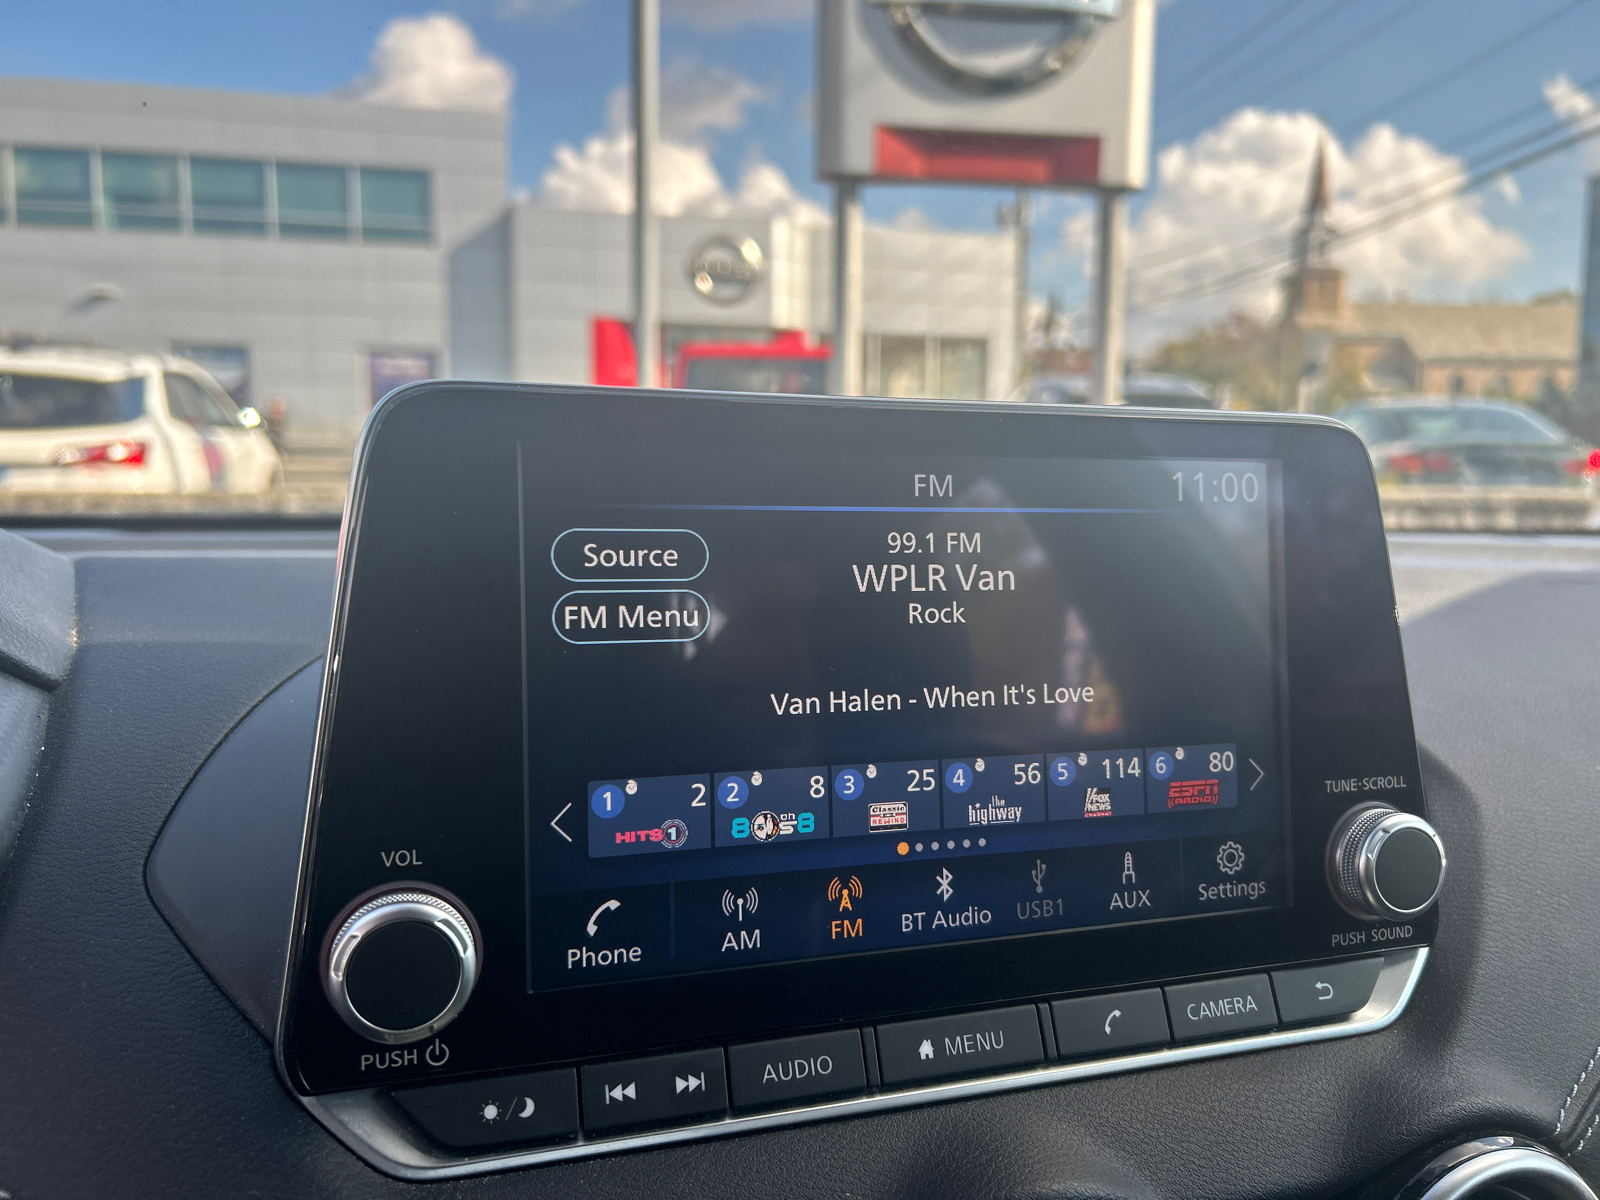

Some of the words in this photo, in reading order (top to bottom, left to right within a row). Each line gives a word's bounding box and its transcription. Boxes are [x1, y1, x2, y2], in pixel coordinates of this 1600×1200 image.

[913, 474, 953, 497] FM
[1171, 471, 1259, 503] 11:00
[887, 532, 935, 554] 99.1
[946, 532, 981, 553] FM
[583, 543, 679, 568] Source
[852, 565, 947, 593] WPLR
[955, 564, 1016, 592] Van
[564, 606, 607, 629] FM
[618, 605, 699, 630] Menu
[908, 601, 966, 624] Rock
[770, 693, 821, 716] Van
[829, 689, 902, 714] Halen
[923, 685, 995, 710] When
[1003, 683, 1036, 707] It's
[1044, 683, 1095, 705] Love
[1057, 763, 1069, 781] 5
[1102, 757, 1141, 779] 114
[1155, 757, 1167, 774] 6
[1209, 751, 1235, 773] 80
[906, 768, 936, 792] 25
[952, 768, 966, 787] 4
[1014, 762, 1042, 785] 56
[690, 783, 707, 807] 2
[726, 783, 740, 802] 2
[809, 775, 826, 798] 8
[843, 776, 856, 794] 3
[1168, 778, 1219, 798] ESPN
[602, 791, 613, 811] 1
[991, 795, 1006, 807] the
[1087, 803, 1112, 812] NEWS
[1092, 793, 1111, 803] FOX
[1174, 795, 1212, 805] RADIO
[872, 817, 905, 825] REWIND
[968, 804, 1022, 825] highway
[381, 849, 423, 867] VOL
[1109, 889, 1151, 911] AUX
[1198, 880, 1266, 902] Settings
[901, 911, 926, 932] BT
[931, 906, 992, 929] Audio
[1016, 898, 1064, 920] USB1
[830, 919, 863, 939] FM
[1331, 931, 1366, 947] PUSH
[1371, 925, 1413, 942] SOUND
[721, 929, 761, 952] AM
[566, 946, 642, 969] Phone
[1186, 995, 1258, 1021] CAMERA
[944, 1031, 1005, 1056] MENU
[360, 1049, 418, 1071] PUSH
[762, 1055, 833, 1084] AUDIO
